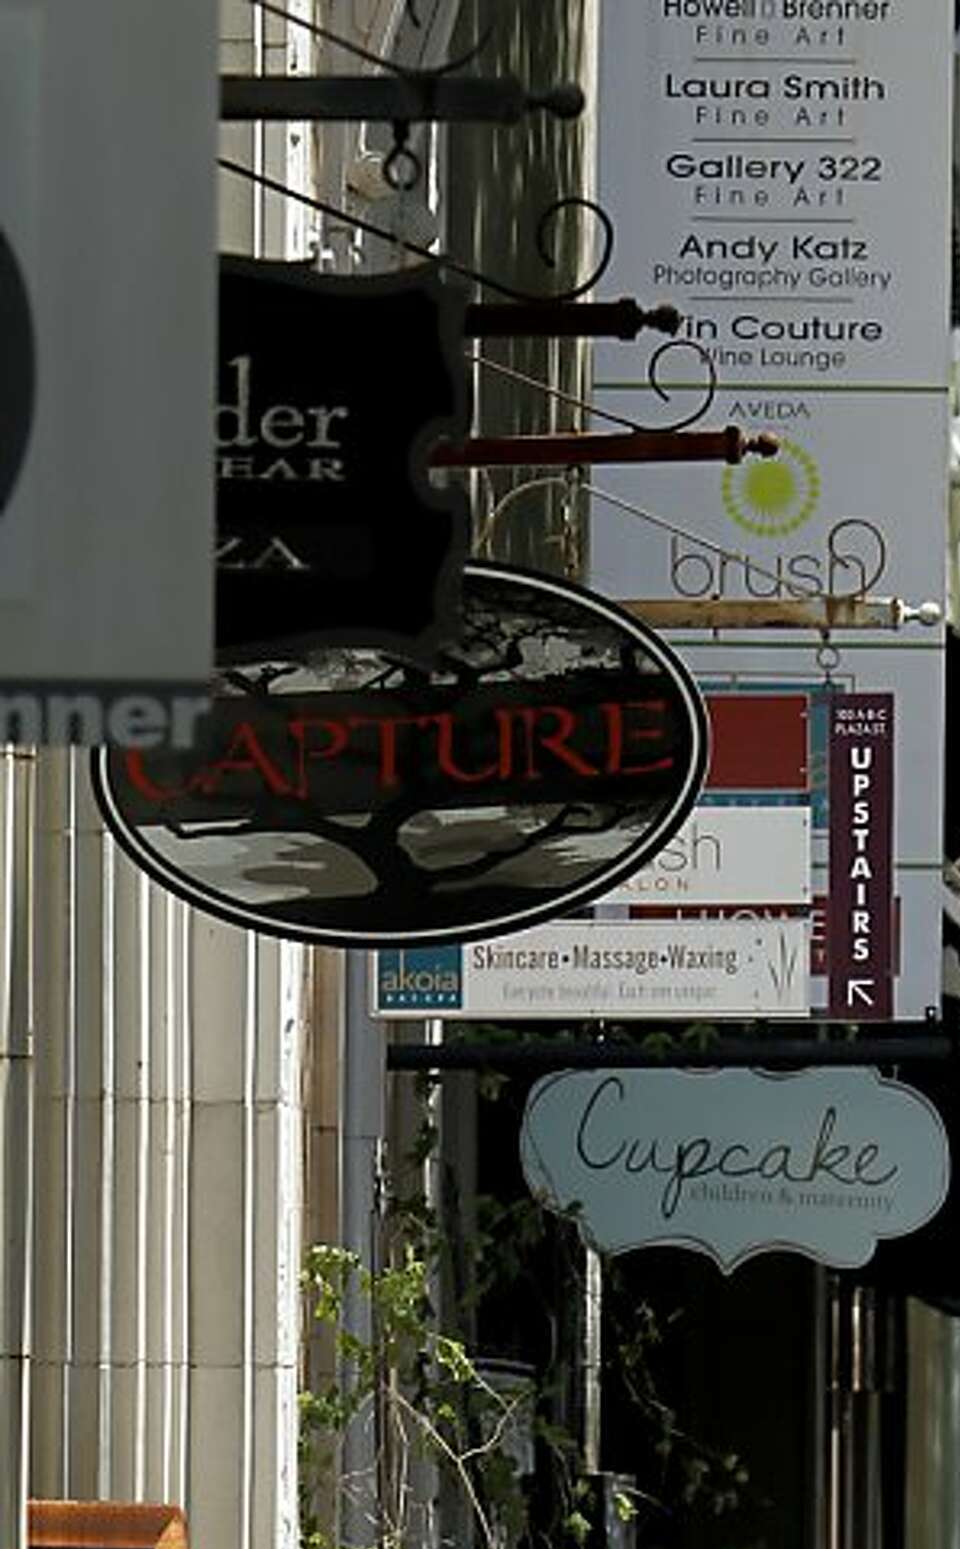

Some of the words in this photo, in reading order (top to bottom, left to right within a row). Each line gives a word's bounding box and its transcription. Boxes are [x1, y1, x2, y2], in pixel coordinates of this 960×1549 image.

[782, 0, 890, 20] Brenner
[695, 25, 769, 45] Fine
[796, 26, 844, 46] Art
[666, 74, 769, 99] Laura
[784, 75, 885, 100] Smith
[695, 106, 769, 125] Fine
[795, 107, 844, 126] Art
[666, 154, 804, 183] Gallery
[818, 156, 882, 182] 322
[694, 186, 769, 206] Fine
[794, 187, 843, 206] Art
[679, 235, 778, 263] Andy
[793, 235, 869, 260] Katz
[653, 264, 801, 290] Photography
[809, 267, 892, 290] Gallery
[680, 315, 717, 340] in
[731, 315, 883, 340] Couture
[760, 349, 845, 371] Lounge
[728, 402, 811, 419] AVEDA
[671, 535, 867, 600] brush
[653, 823, 720, 871] sh
[850, 747, 873, 961] UPSTAIRS
[381, 949, 459, 991] akoia
[472, 945, 559, 970] Skincare
[573, 946, 666, 975] Massage
[669, 947, 738, 974] Waxing
[576, 1077, 898, 1219] Cupcake
